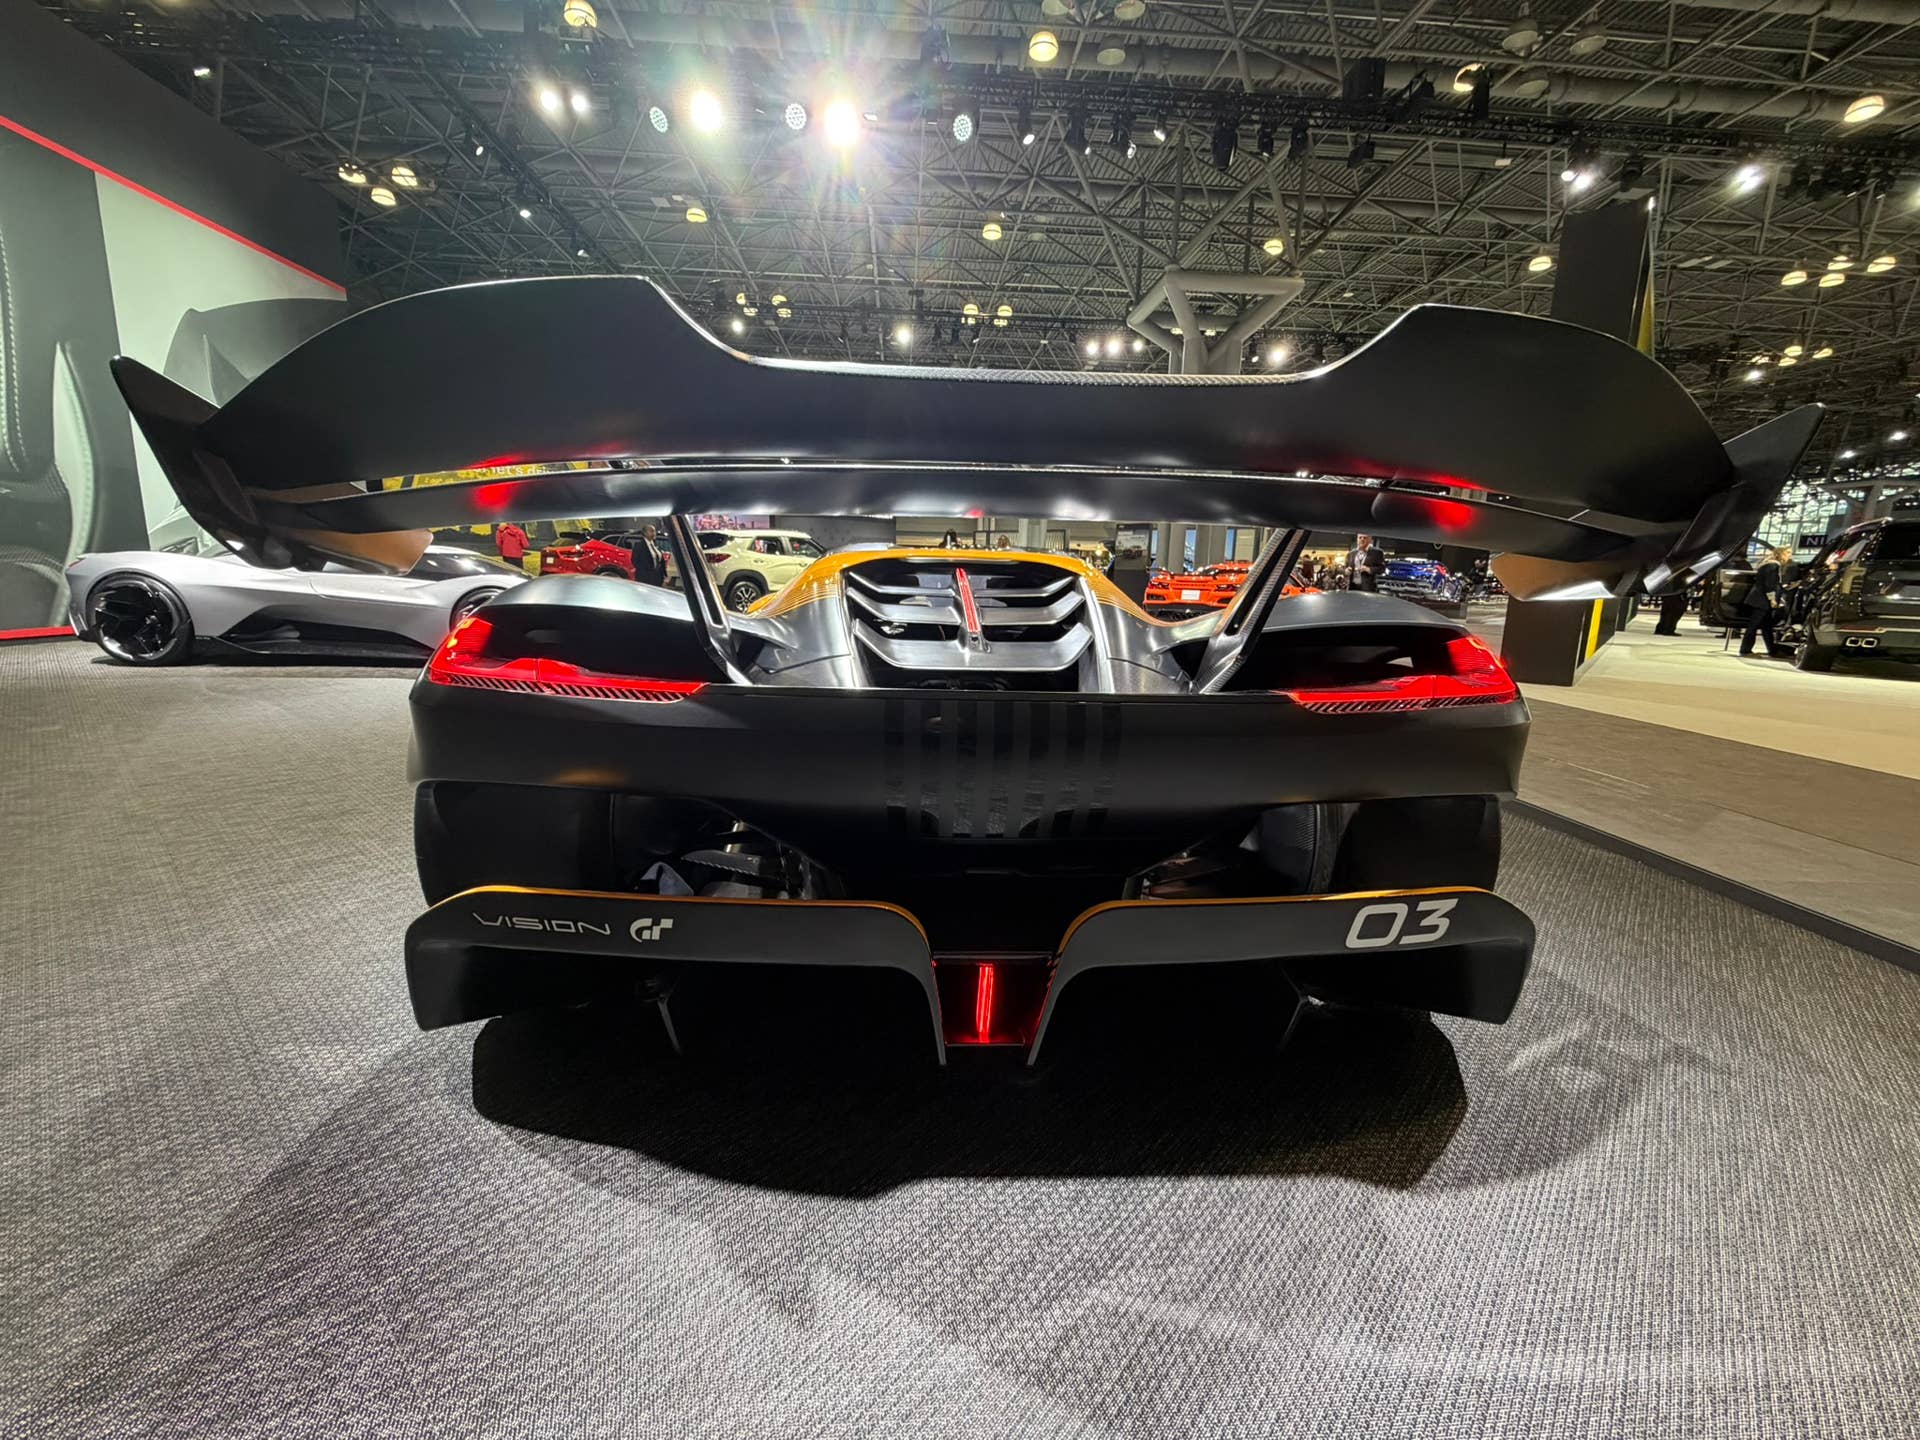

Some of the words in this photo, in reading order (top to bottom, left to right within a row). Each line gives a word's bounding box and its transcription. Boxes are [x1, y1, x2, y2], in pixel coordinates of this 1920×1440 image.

[473, 912, 611, 936] VISION
[629, 917, 674, 942] GT
[1345, 898, 1459, 949] 03
